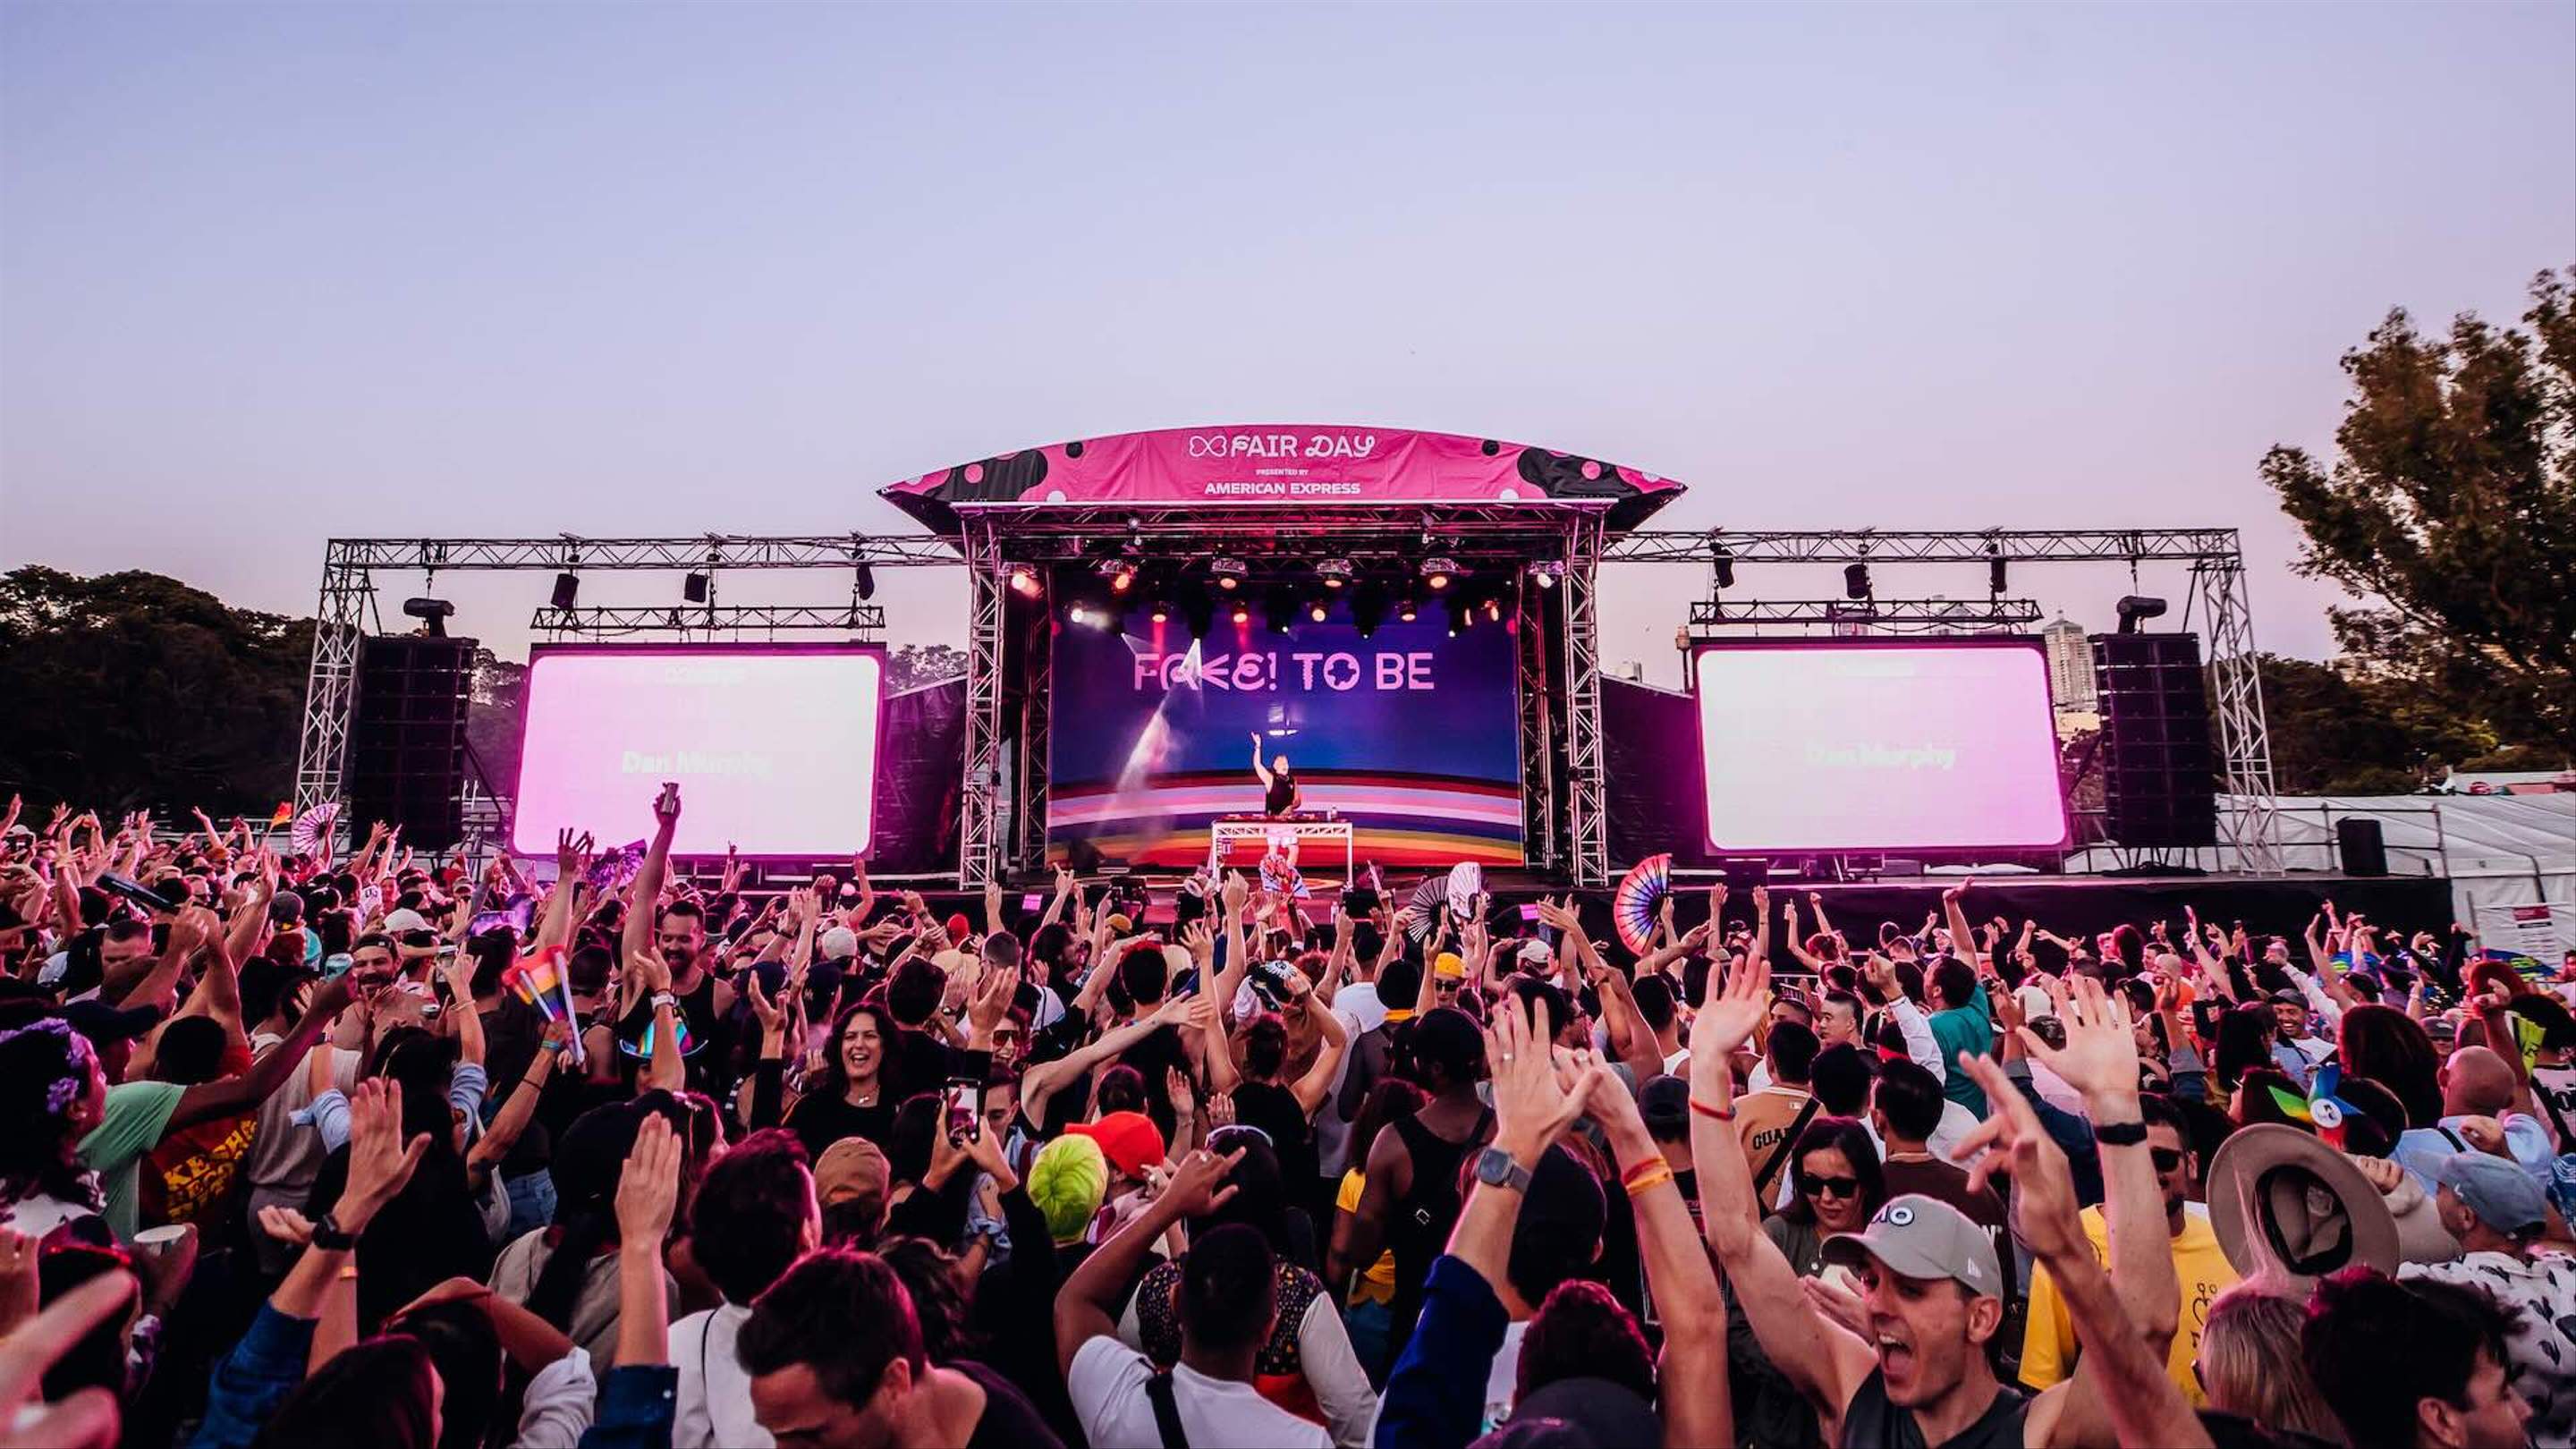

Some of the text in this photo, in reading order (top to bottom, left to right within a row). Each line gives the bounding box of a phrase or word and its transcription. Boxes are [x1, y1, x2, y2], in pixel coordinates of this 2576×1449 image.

[1231, 435, 1376, 458] FAIR DAY
[1205, 483, 1361, 495] AMERICAN EXPRESS
[1292, 652, 1361, 691] TO
[1376, 652, 1435, 691] BE
